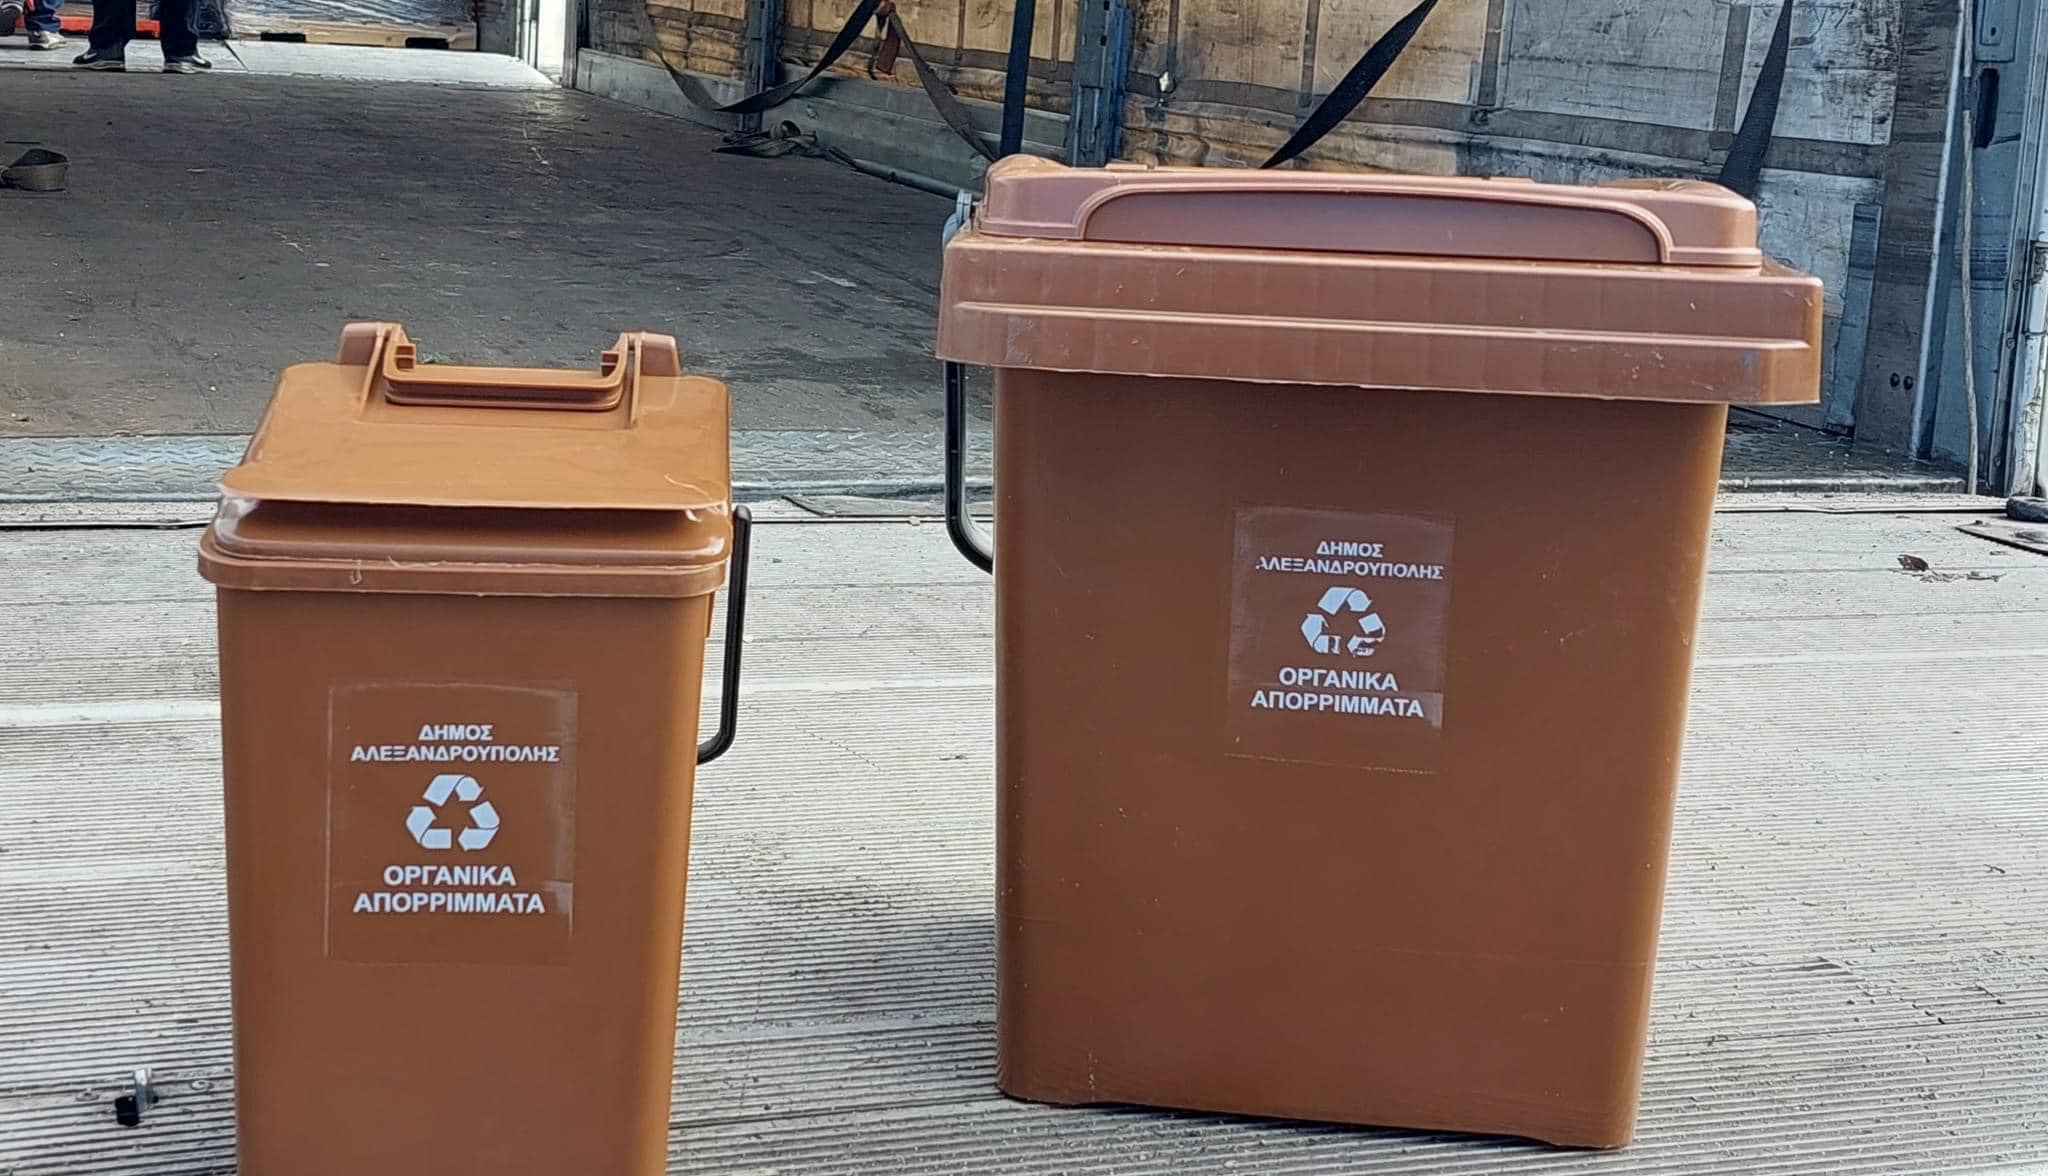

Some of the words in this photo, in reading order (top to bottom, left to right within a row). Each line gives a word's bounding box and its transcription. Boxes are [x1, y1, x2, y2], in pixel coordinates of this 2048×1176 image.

[1316, 541, 1384, 558] ΔΗΜΟΣ
[1279, 667, 1399, 692] ΟΡΓΑΝΙΚΑ
[1251, 690, 1424, 718] ΑΠΟΡΡΙΜΜΑΤΑ
[418, 724, 493, 741] ΔΗΜΟΣ
[351, 745, 560, 762] ΑΛΕΞΑΝΔΡΟΥΠΟΛΗΣ
[383, 865, 516, 886] ΟΡΓΑΝΙΚΑ
[353, 892, 545, 914] ΑΠΟΡΡΙΜΜΑΤΑ
